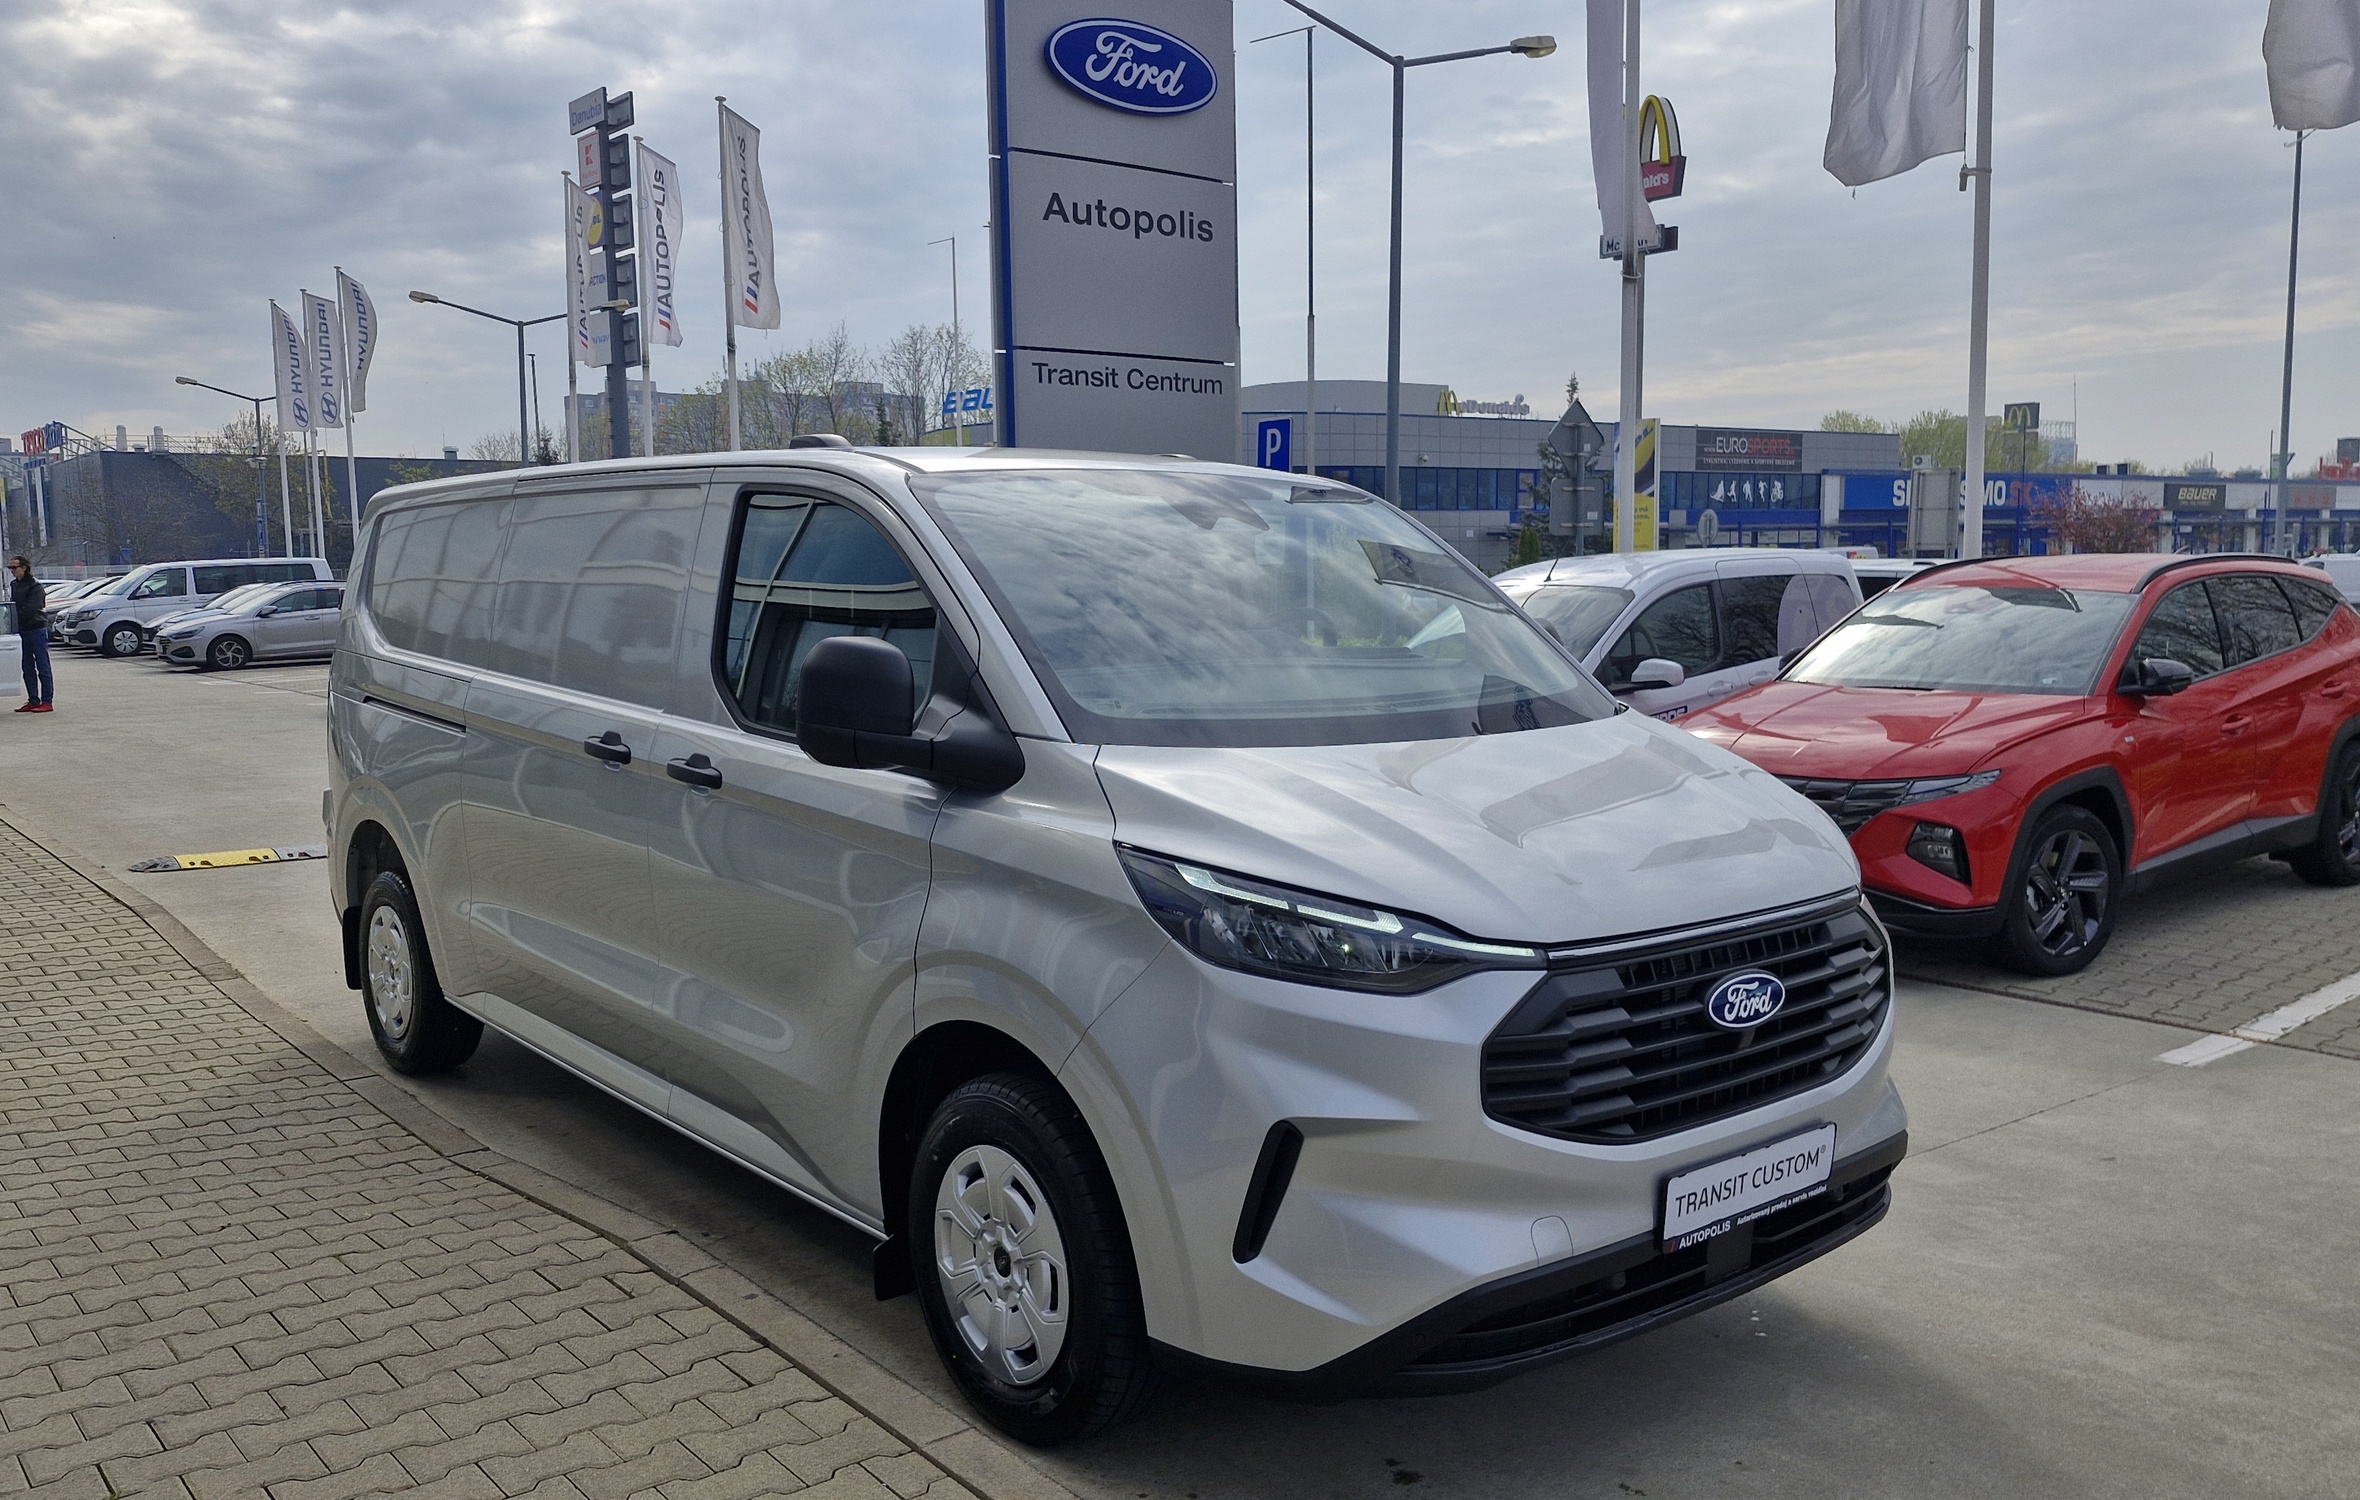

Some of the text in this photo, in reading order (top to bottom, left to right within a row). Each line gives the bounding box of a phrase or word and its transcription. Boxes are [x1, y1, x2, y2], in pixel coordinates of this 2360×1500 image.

[1085, 31, 1187, 97] Ford
[1643, 172, 1670, 188] ald's
[1042, 192, 1214, 242] Autopolis
[317, 303, 333, 387] HYUNDAI
[350, 282, 369, 370] HYUNDAI
[282, 313, 303, 393] HYUNDAI
[1032, 362, 1223, 395] Transit Centrum
[1265, 428, 1282, 467] P
[1724, 981, 1773, 1021] Ford
[1675, 1172, 1748, 1218] TRANSIT
[1679, 1220, 1731, 1249] AUTOPOLIS
